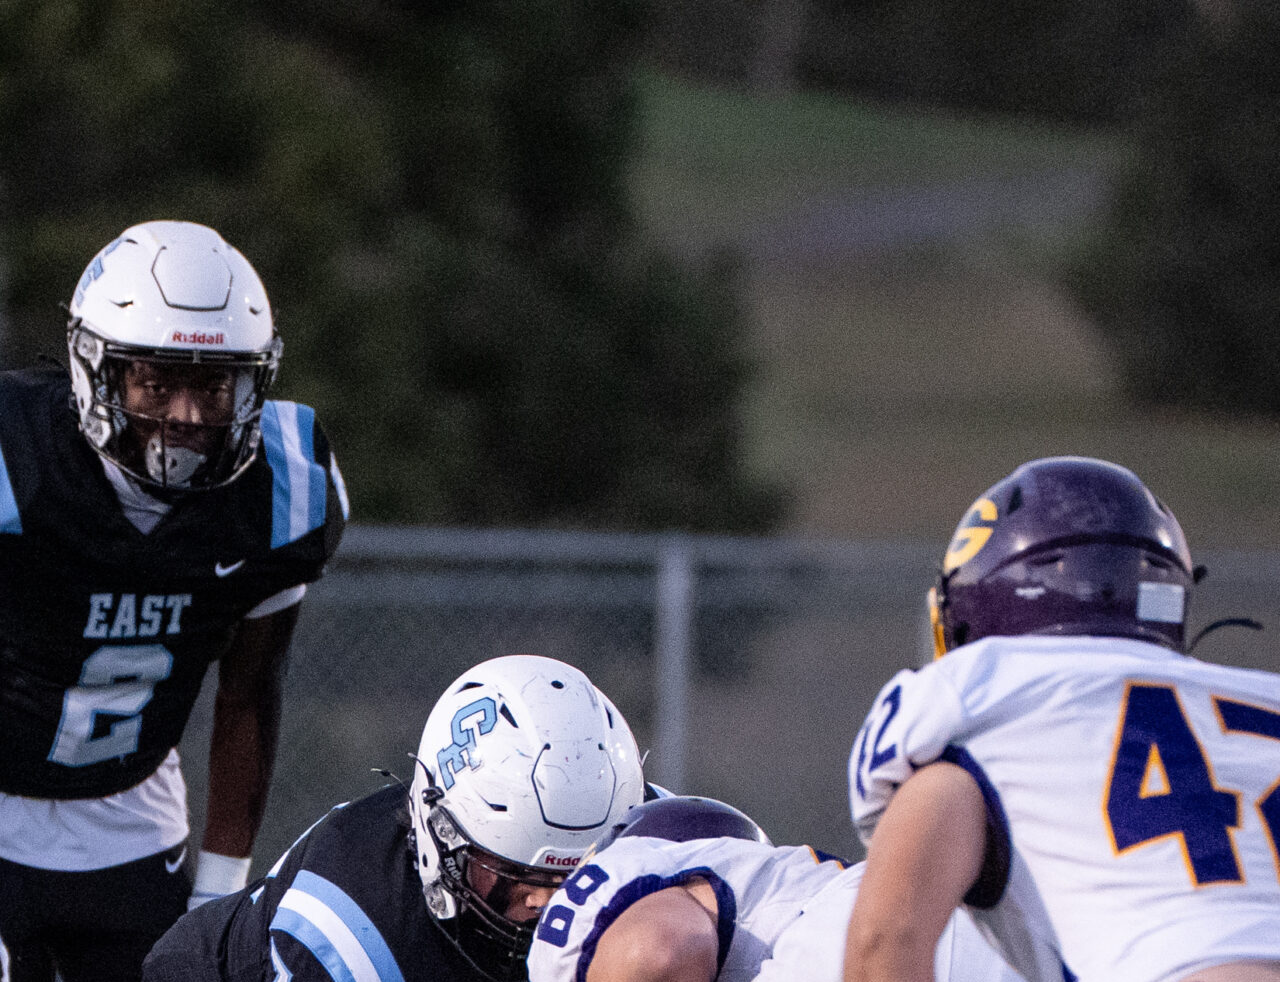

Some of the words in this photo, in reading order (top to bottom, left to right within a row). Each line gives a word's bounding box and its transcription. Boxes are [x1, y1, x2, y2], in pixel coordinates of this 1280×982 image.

[172, 331, 224, 345] Riddell
[944, 498, 999, 572] G
[83, 593, 193, 639] EAST
[47, 643, 175, 768] 2
[544, 854, 581, 866] Ridd
